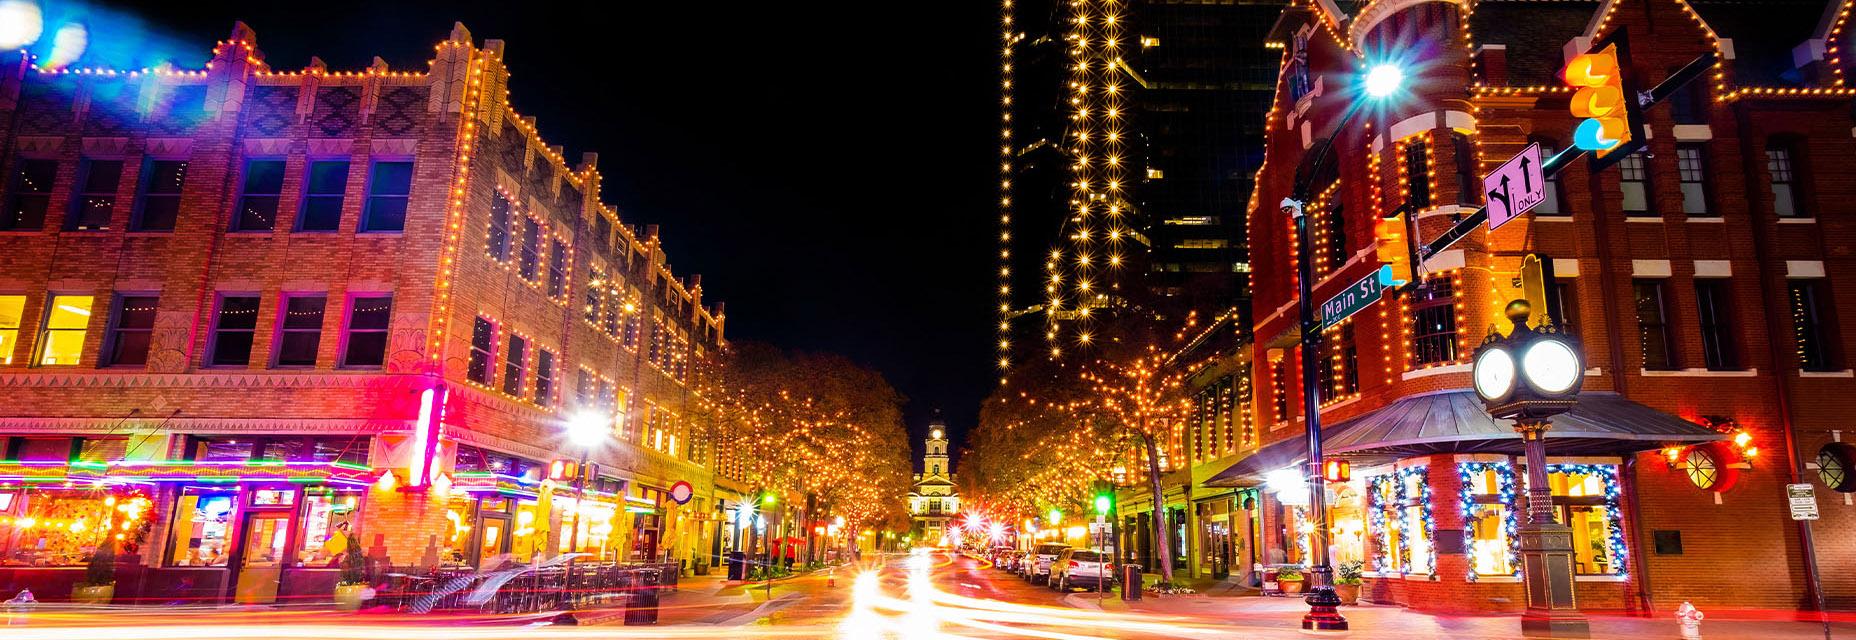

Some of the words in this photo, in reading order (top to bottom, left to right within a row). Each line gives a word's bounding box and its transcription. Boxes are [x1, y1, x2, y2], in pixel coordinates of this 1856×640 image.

[1518, 189, 1542, 211] ONLY
[1325, 293, 1355, 320] Main
[1360, 277, 1375, 299] St
